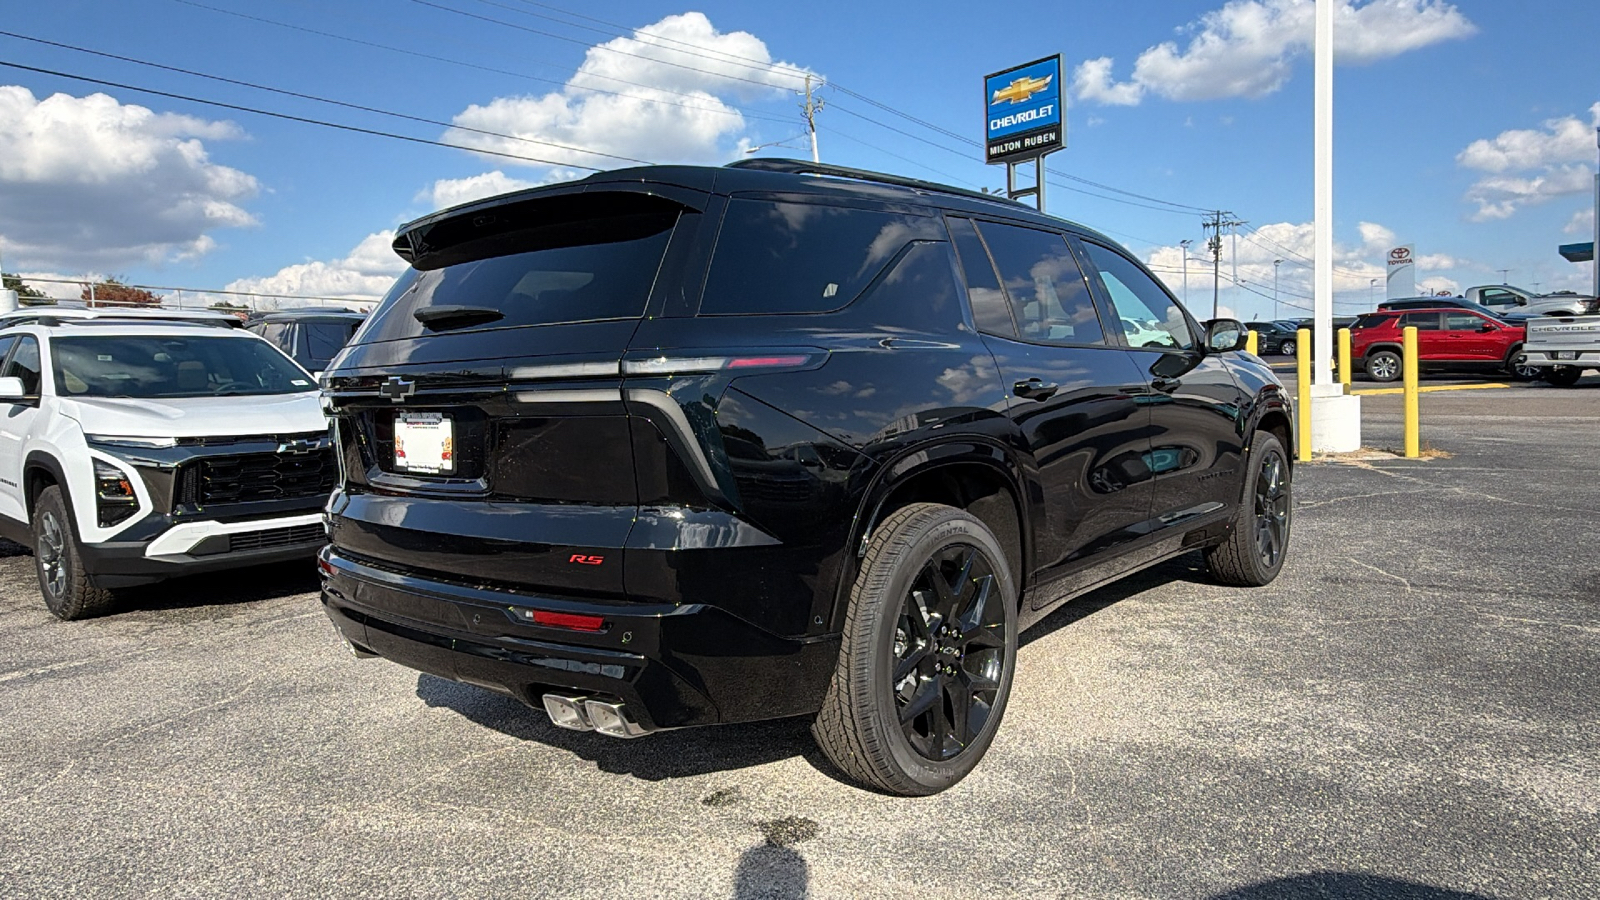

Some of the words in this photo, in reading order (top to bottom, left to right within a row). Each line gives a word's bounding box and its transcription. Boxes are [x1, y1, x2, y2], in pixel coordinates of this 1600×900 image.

[990, 104, 1054, 131] CHEVROLET
[989, 139, 1021, 156] MILTON
[1024, 132, 1056, 147] RUBEN
[1388, 258, 1413, 266] TOYOTA
[569, 554, 604, 565] RS
